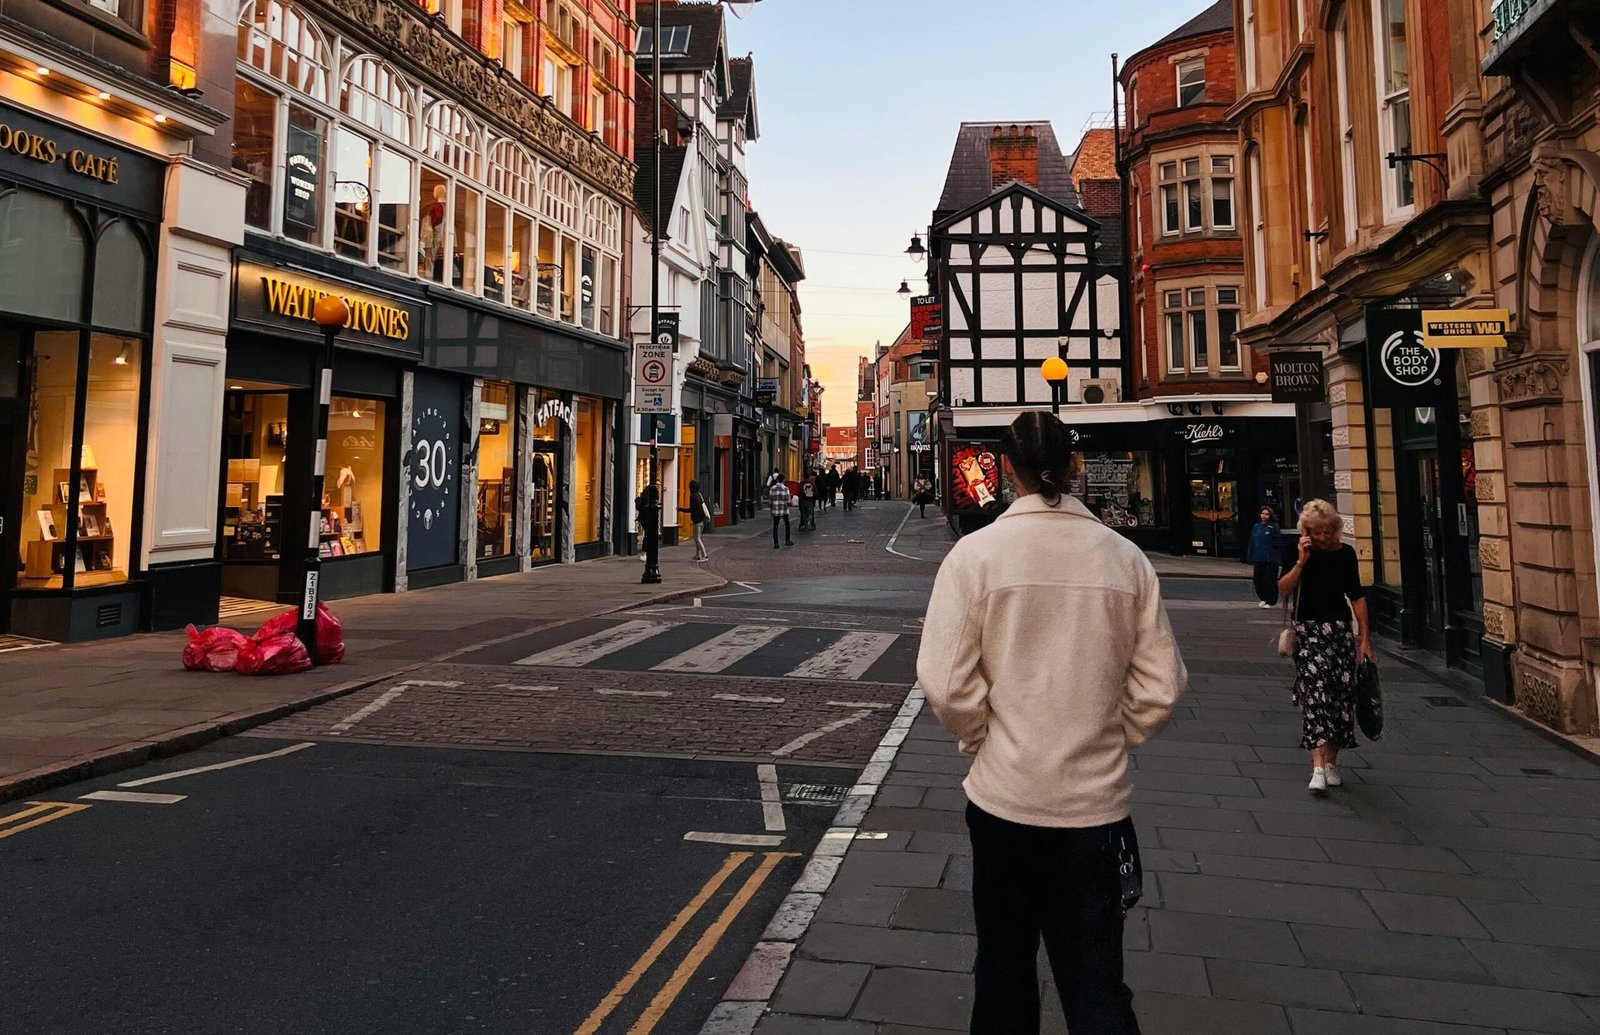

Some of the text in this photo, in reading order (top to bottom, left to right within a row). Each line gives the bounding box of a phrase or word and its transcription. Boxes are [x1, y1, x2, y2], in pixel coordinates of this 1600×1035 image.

[70, 149, 119, 184] CAFÉ
[925, 296, 936, 304] LET
[1429, 322, 1473, 330] WESTERN
[1443, 328, 1473, 336] UNION
[1476, 321, 1501, 335] WU
[1399, 346, 1421, 356] THE
[1392, 355, 1430, 366] BODY
[1273, 362, 1320, 374] MOLTON
[1395, 365, 1429, 376] SHOP
[1275, 374, 1320, 386] BROWN
[537, 398, 576, 431] FATFACE
[1184, 423, 1224, 440] Kiehl's
[415, 439, 447, 488] 30
